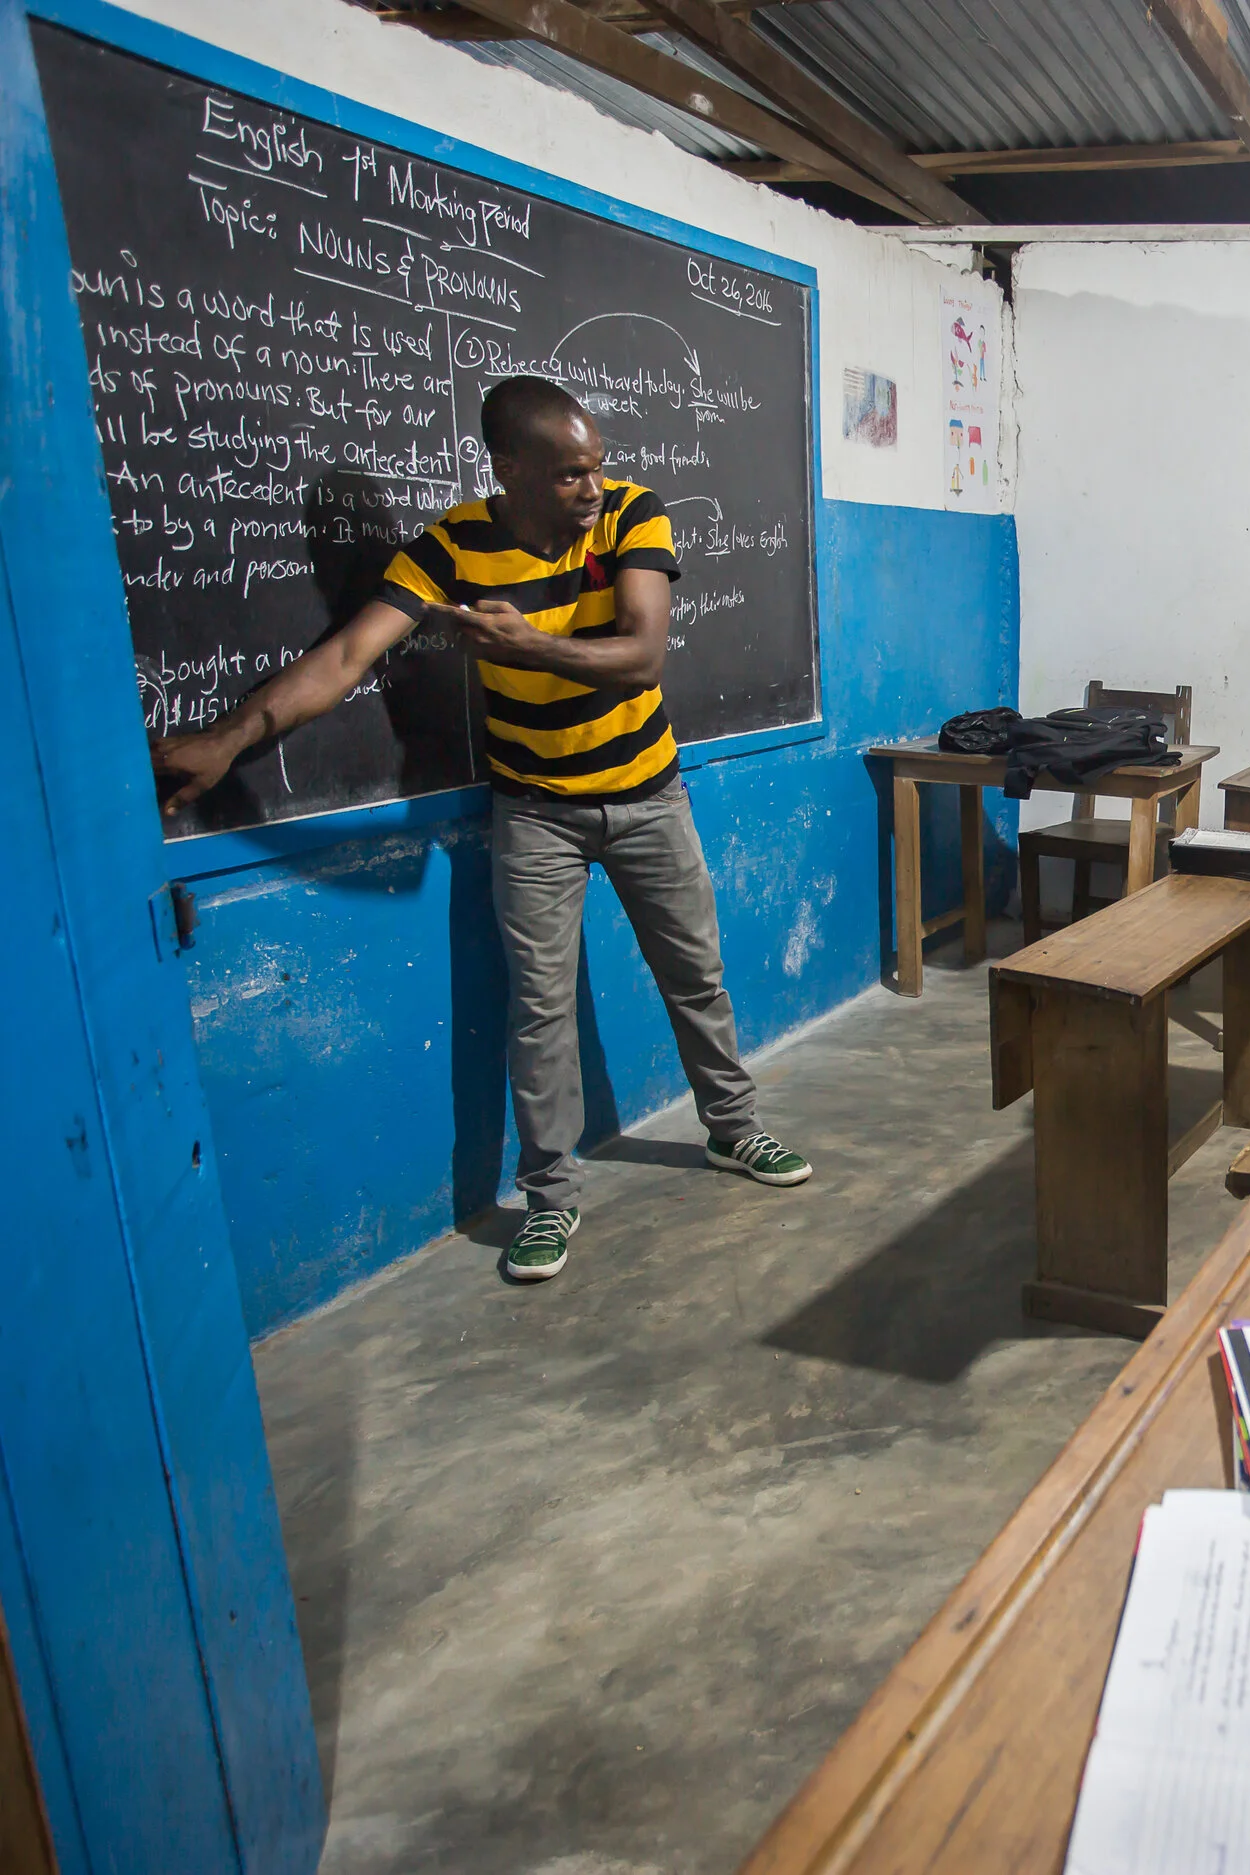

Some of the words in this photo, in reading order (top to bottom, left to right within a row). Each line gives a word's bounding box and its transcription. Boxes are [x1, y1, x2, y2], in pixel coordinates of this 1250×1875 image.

[203, 97, 323, 172] English
[342, 146, 377, 202] 1st
[390, 162, 477, 247] Marking
[478, 200, 531, 246] Period
[188, 174, 277, 249] Topic:
[300, 222, 391, 274] NOUNS
[421, 253, 521, 312] PRONOUNS
[71, 268, 129, 303] oun
[177, 289, 195, 314] a
[203, 290, 275, 327] word
[280, 301, 342, 342] that
[353, 311, 372, 347] is
[383, 323, 433, 361] used
[745, 283, 773, 312] 2016
[97, 320, 202, 360] instead
[213, 334, 246, 373] of
[256, 346, 271, 367] a
[352, 352, 415, 392] There
[423, 375, 452, 396] are
[486, 340, 562, 377] Rebecca
[568, 357, 598, 388] will
[599, 361, 643, 396] travel
[690, 377, 715, 403] She
[739, 387, 761, 410] be
[130, 368, 157, 414] of
[306, 387, 352, 423] But
[355, 399, 392, 431] for
[403, 405, 436, 428] our
[95, 404, 127, 445] ill
[142, 411, 177, 445] be
[188, 414, 291, 472] studying
[294, 431, 336, 464] the
[343, 437, 455, 477] antecedent
[617, 450, 636, 463] are
[640, 443, 665, 471] good
[107, 460, 165, 492] An
[178, 464, 309, 506] antecedent
[318, 479, 334, 506] is
[342, 493, 355, 512] a
[362, 484, 412, 508] word
[122, 508, 153, 535] to
[164, 504, 195, 551] by
[204, 518, 216, 537] a
[331, 516, 356, 544] It
[362, 519, 408, 545] must
[705, 522, 729, 550] She
[732, 524, 755, 550] loves
[760, 520, 788, 557] English
[121, 556, 183, 592] nder
[193, 558, 235, 589] and
[700, 590, 721, 616] their
[159, 644, 246, 695] bought
[255, 652, 271, 672] a
